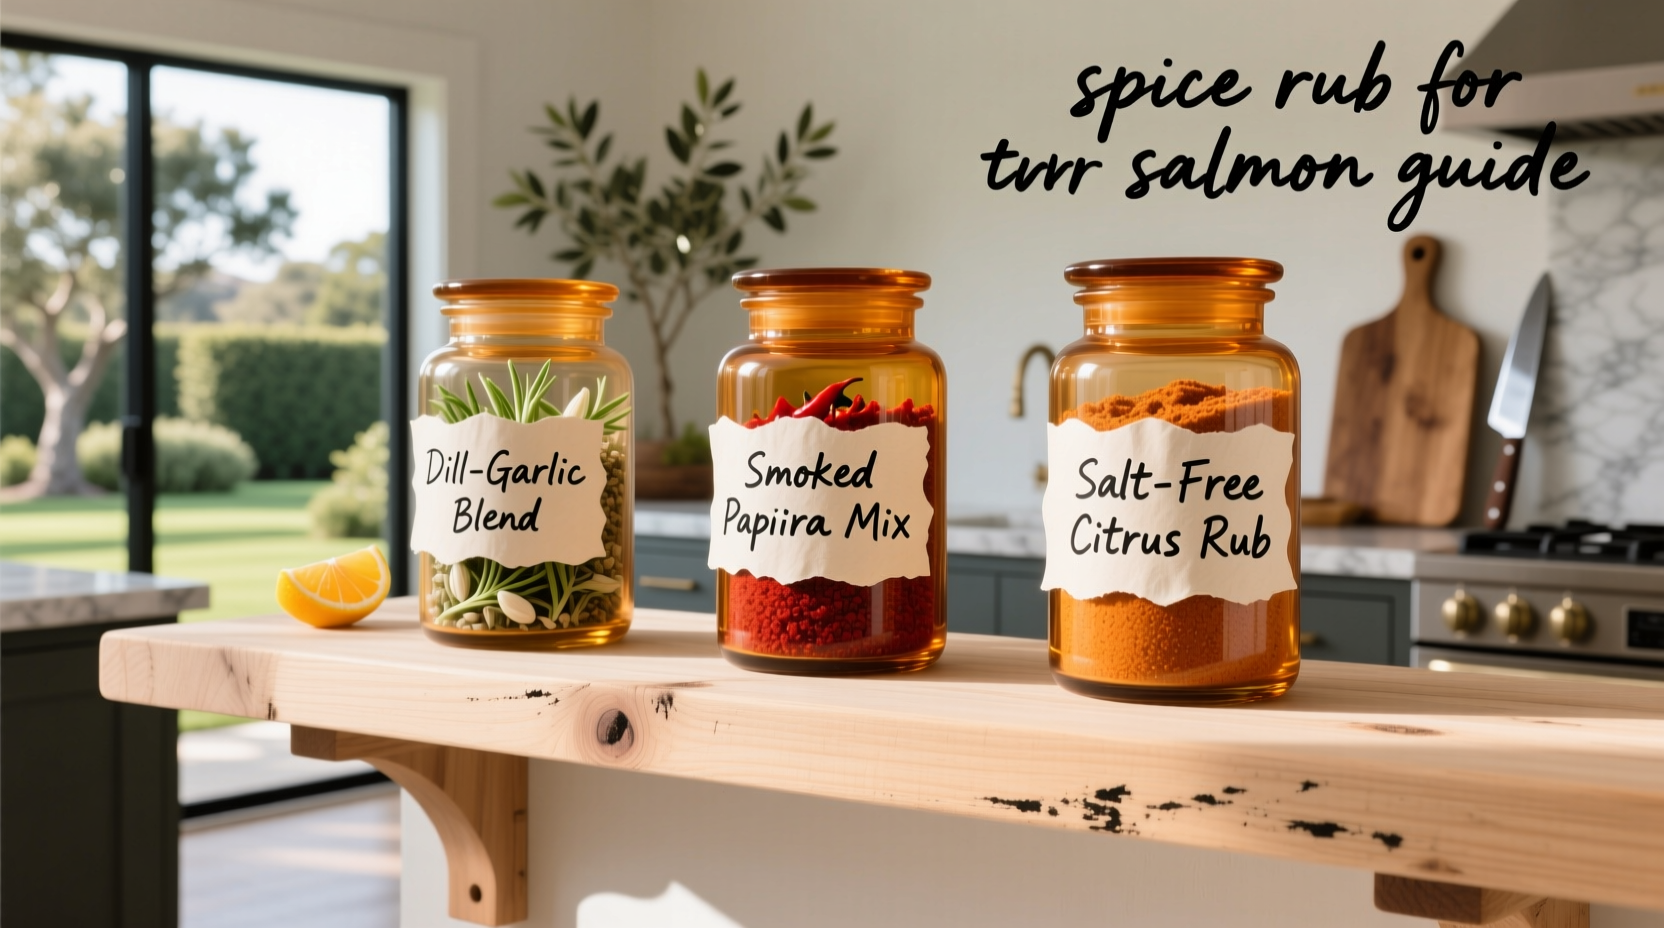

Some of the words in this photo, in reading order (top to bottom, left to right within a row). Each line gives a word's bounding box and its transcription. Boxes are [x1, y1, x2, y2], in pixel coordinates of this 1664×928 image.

[426, 448, 587, 493] Dill-Garlic
[744, 449, 878, 490] Smoked
[1075, 457, 1264, 504] Salt-Free
[453, 496, 543, 534] Blend
[723, 497, 832, 552] Papiira
[844, 501, 911, 542] Mix
[1070, 512, 1182, 558] Citrus
[1199, 513, 1272, 560] Rub
